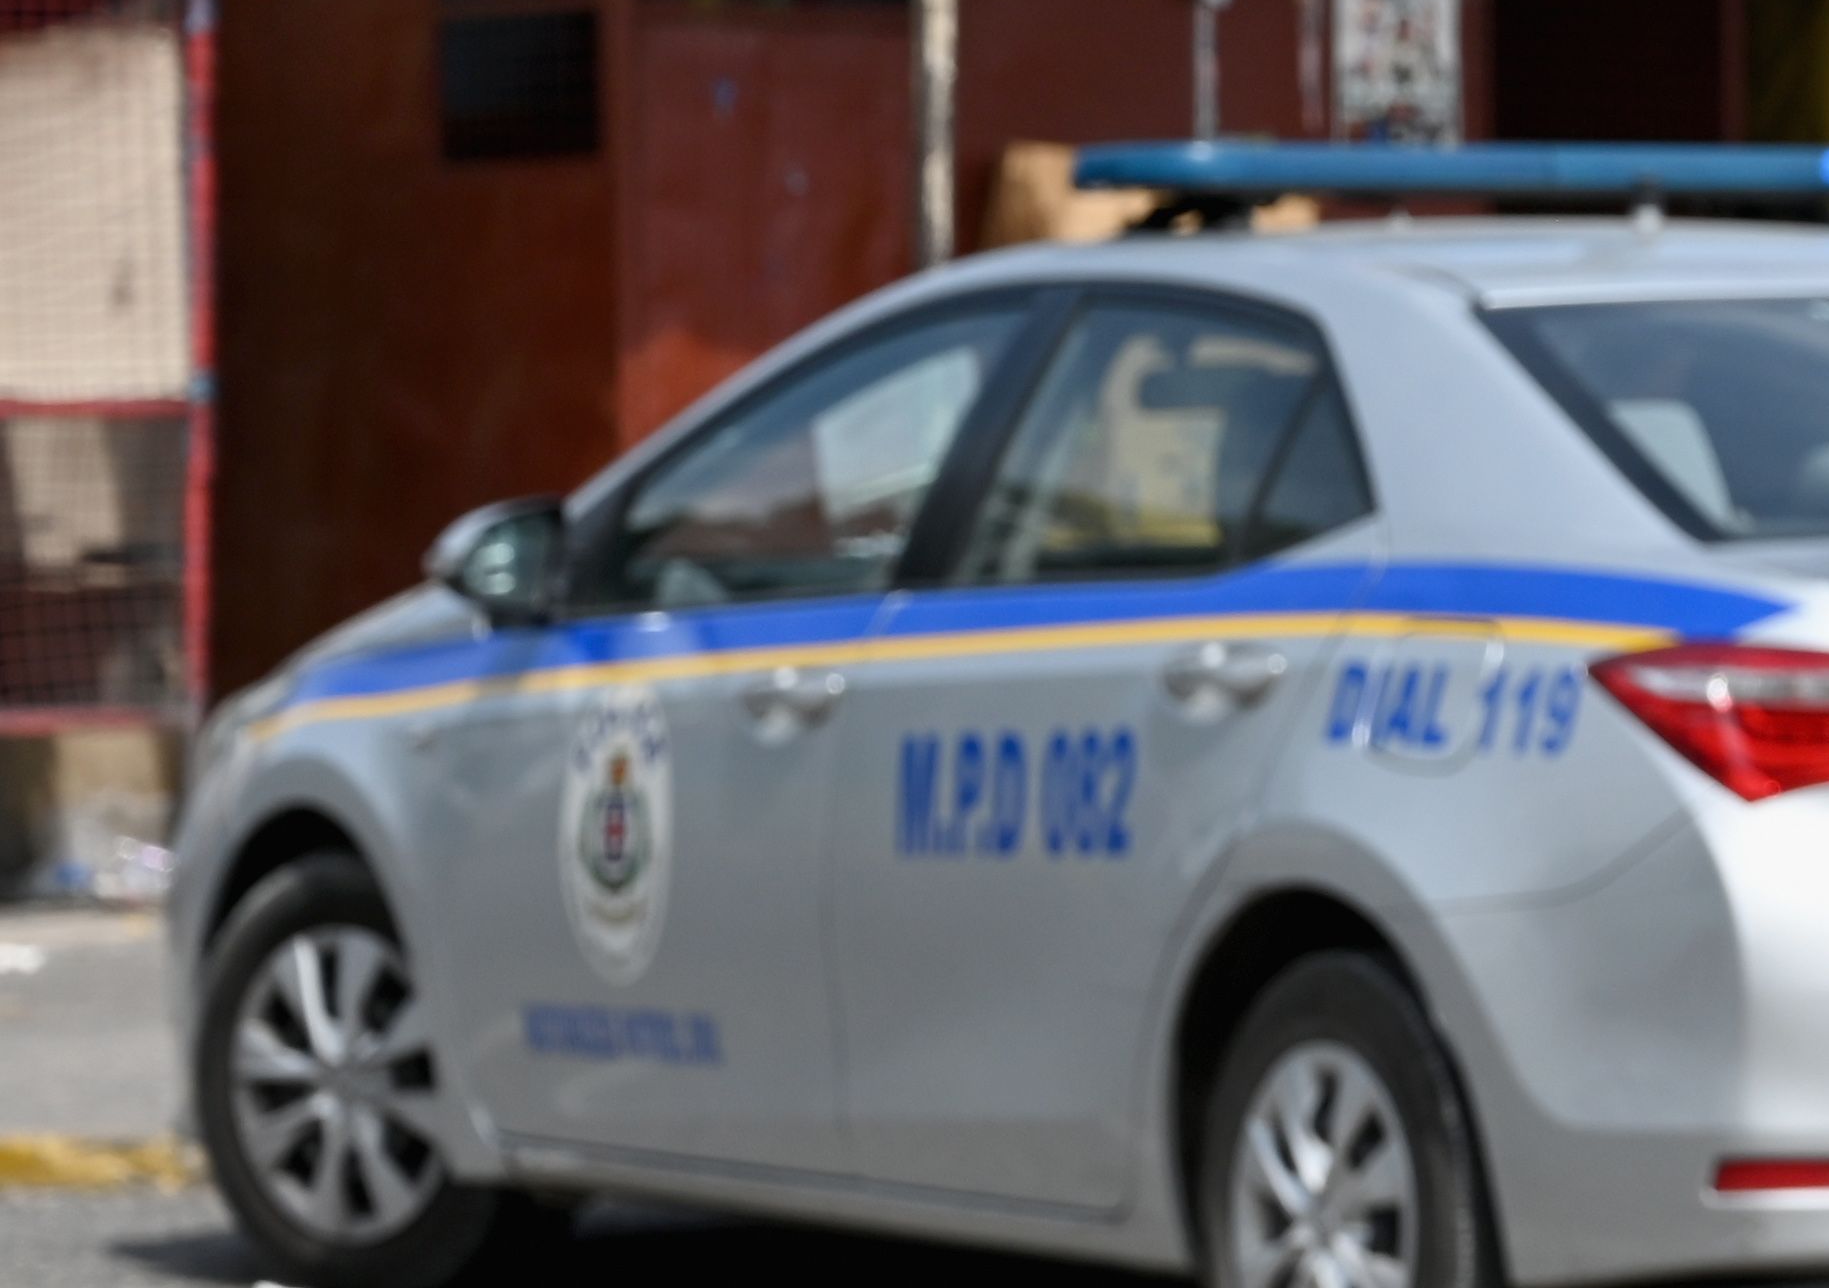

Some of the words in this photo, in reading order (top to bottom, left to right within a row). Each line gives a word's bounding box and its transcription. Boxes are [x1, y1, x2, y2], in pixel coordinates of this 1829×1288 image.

[1324, 660, 1448, 748] DIAL
[1477, 663, 1584, 759] 119
[1042, 727, 1138, 858] 082
